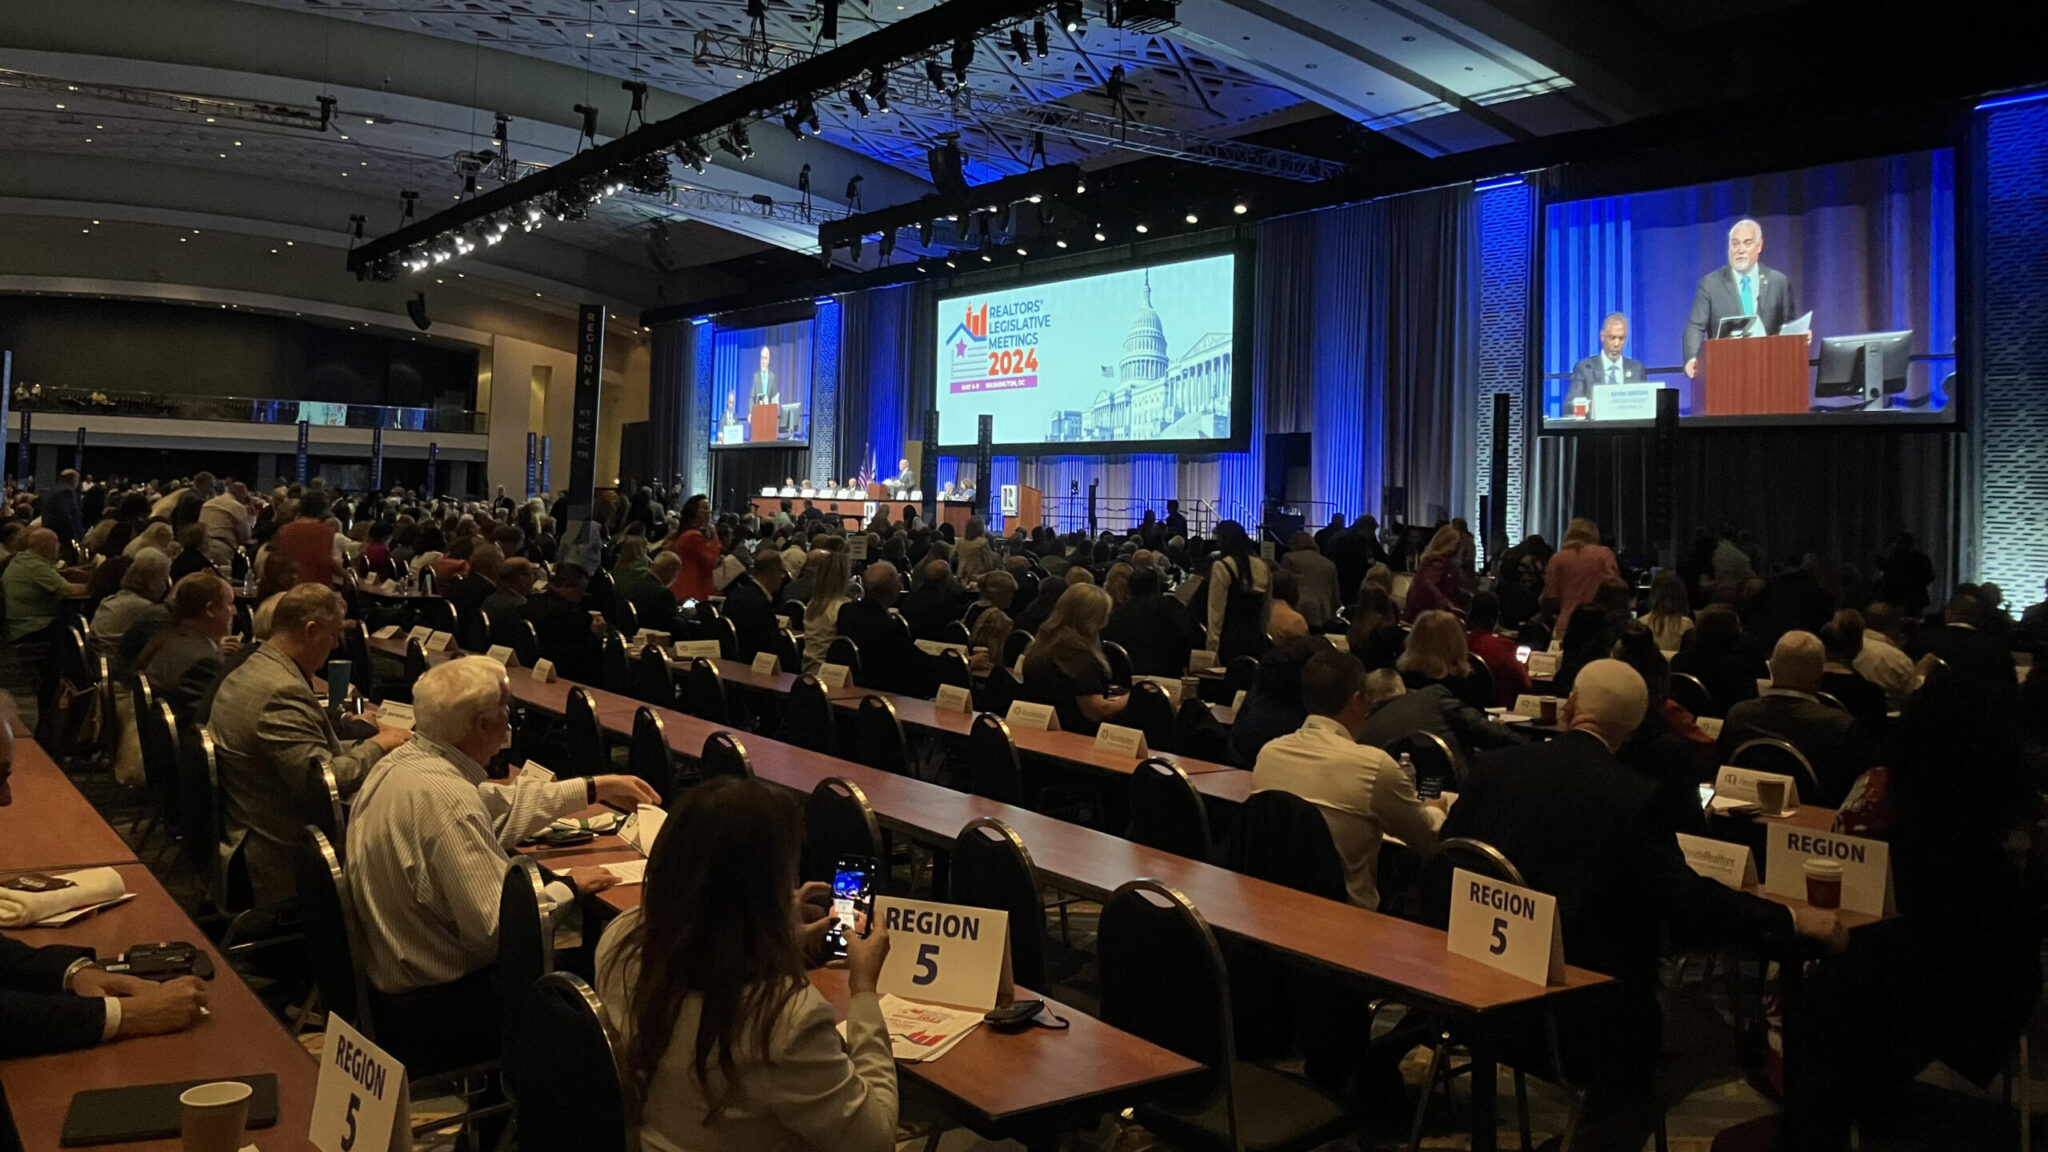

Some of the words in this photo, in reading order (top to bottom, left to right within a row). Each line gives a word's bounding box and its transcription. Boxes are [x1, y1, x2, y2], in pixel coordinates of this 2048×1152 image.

[584, 312, 595, 374] REGION
[988, 332, 1039, 350] MEETINGS
[989, 314, 1051, 334] LEGISLATIVE
[988, 347, 1039, 376] 2024
[1787, 833, 1865, 863] REGION
[1469, 881, 1535, 921] REGION
[886, 906, 980, 941] REGION
[1489, 917, 1508, 956] 5
[912, 943, 940, 986] 5
[335, 1034, 386, 1101] REGION
[341, 1092, 361, 1152] 5
